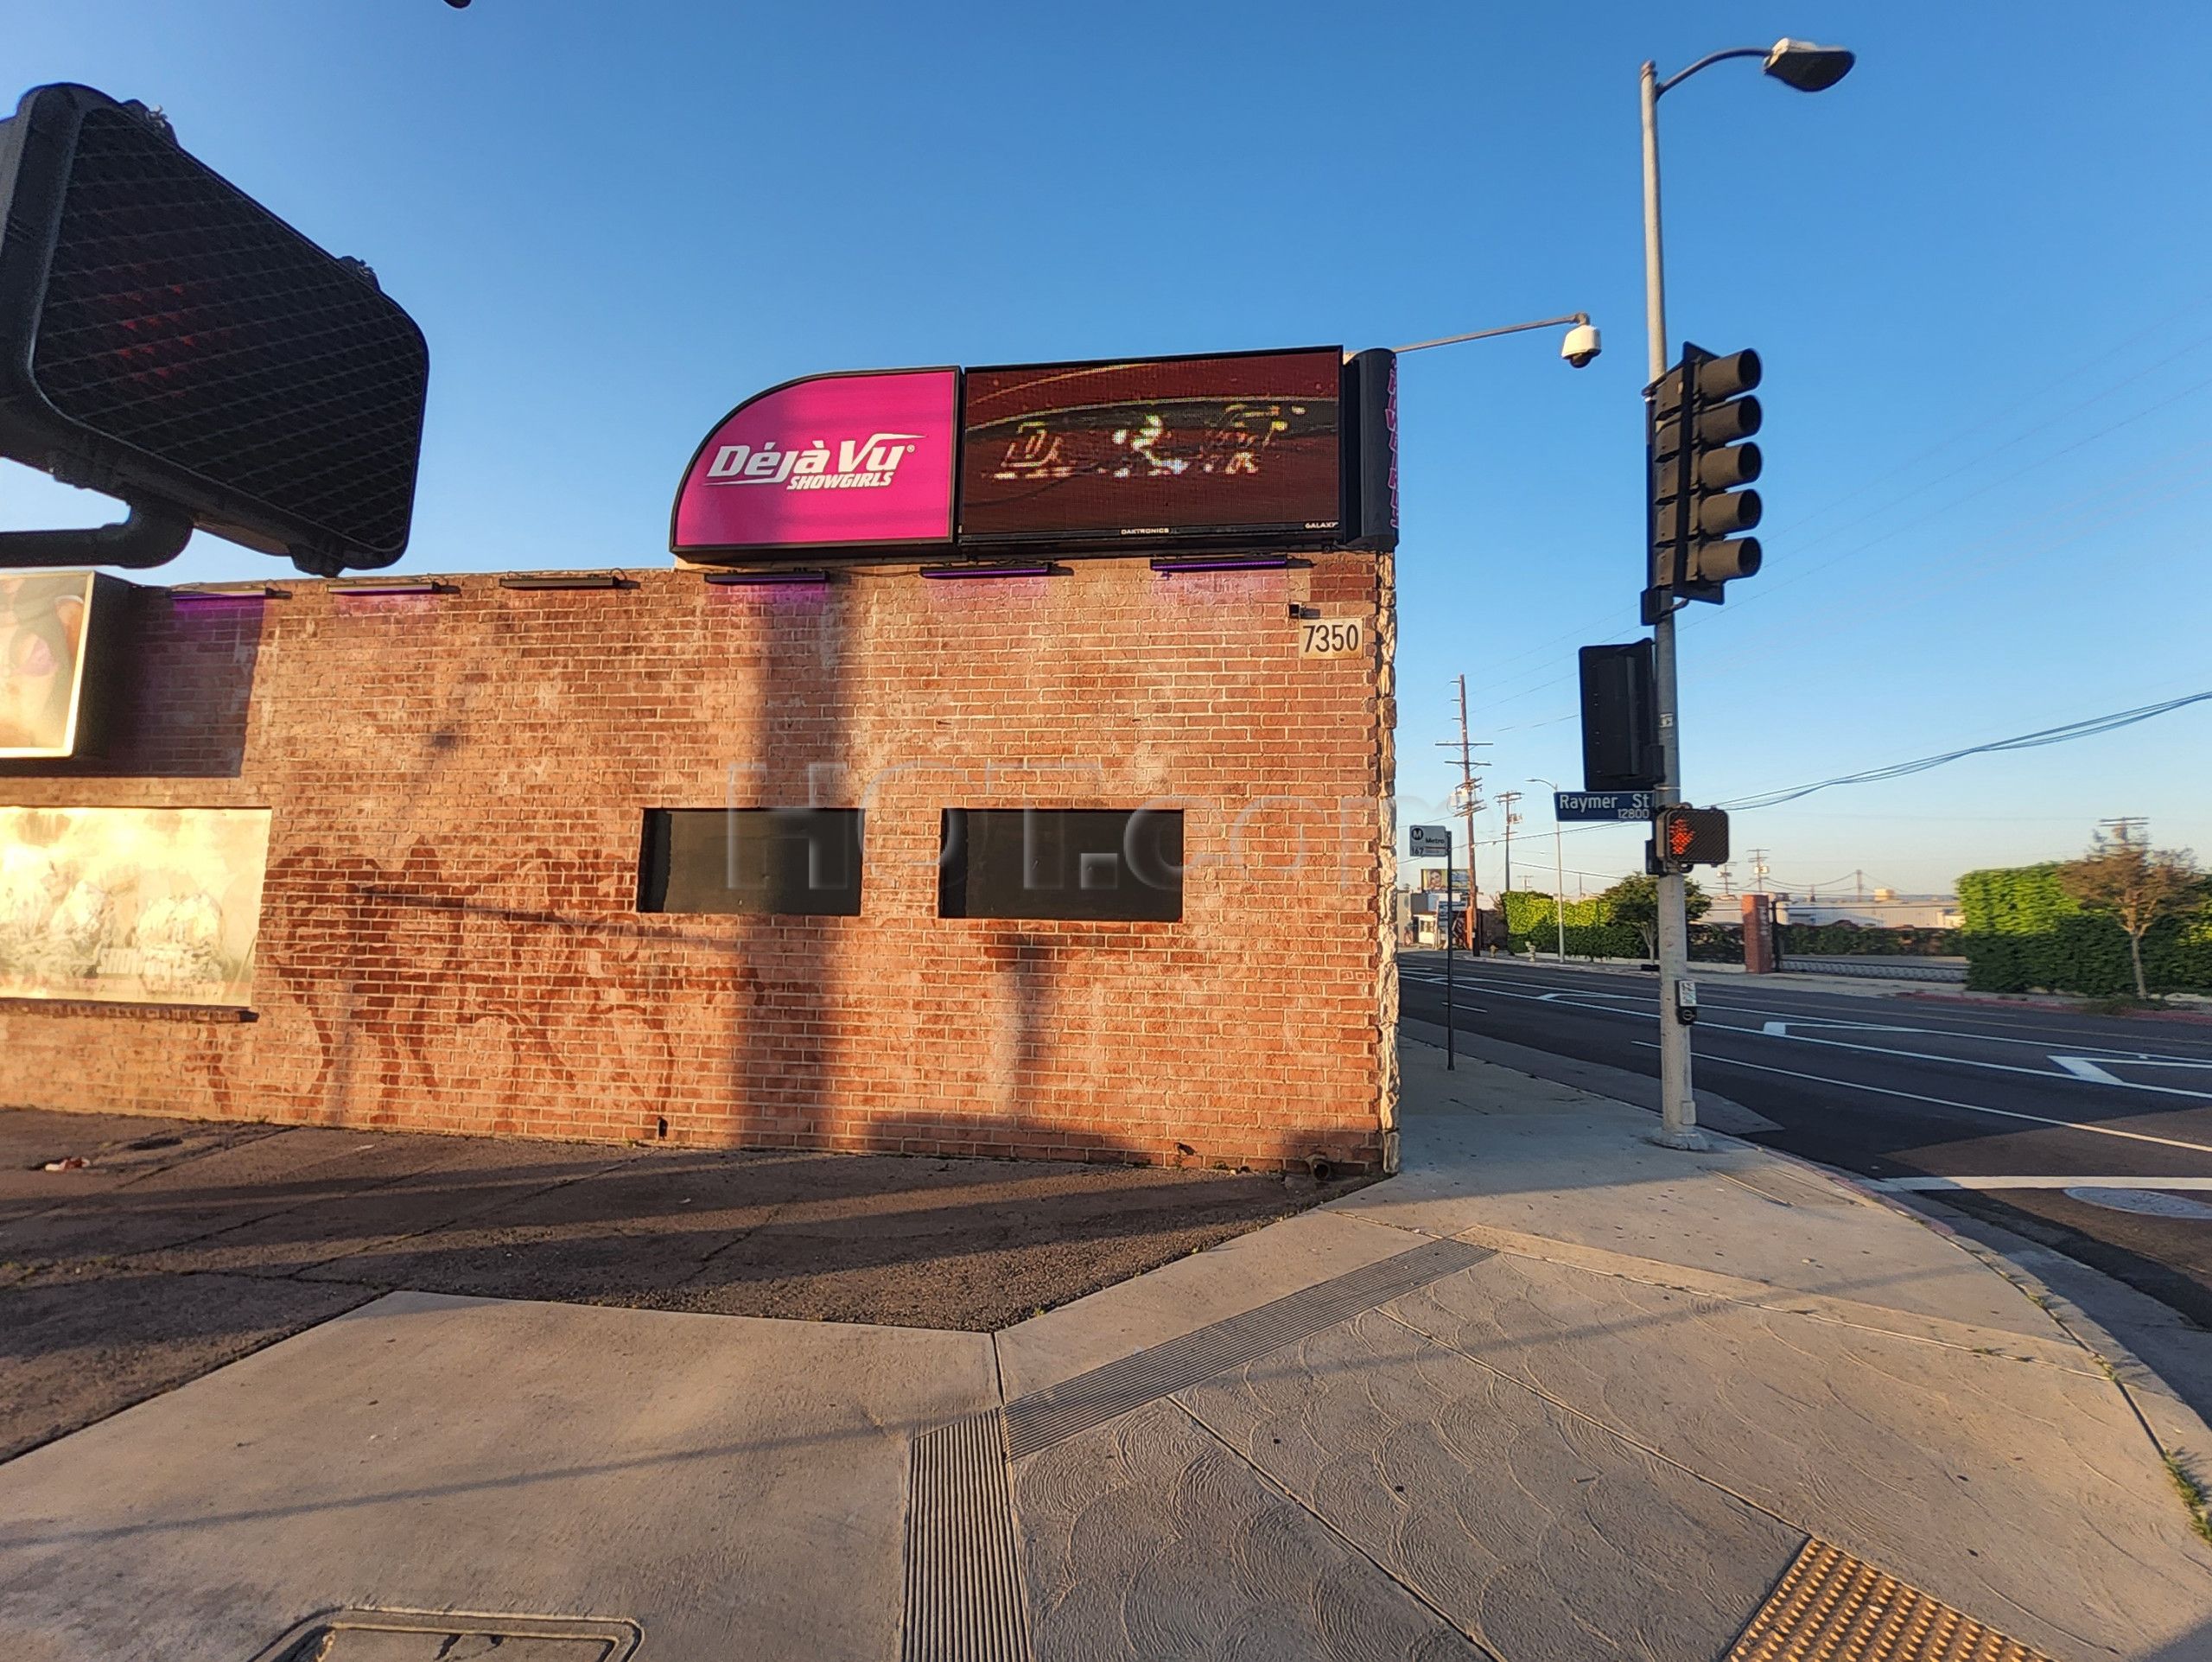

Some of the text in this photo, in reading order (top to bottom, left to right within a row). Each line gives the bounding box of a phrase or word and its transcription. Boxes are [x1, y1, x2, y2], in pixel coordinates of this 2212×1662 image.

[786, 471, 894, 490] SHOWGIRLS
[1302, 624, 1359, 653] 7350
[1560, 793, 1649, 813] Raymer St
[1617, 808, 1649, 818] 12800
